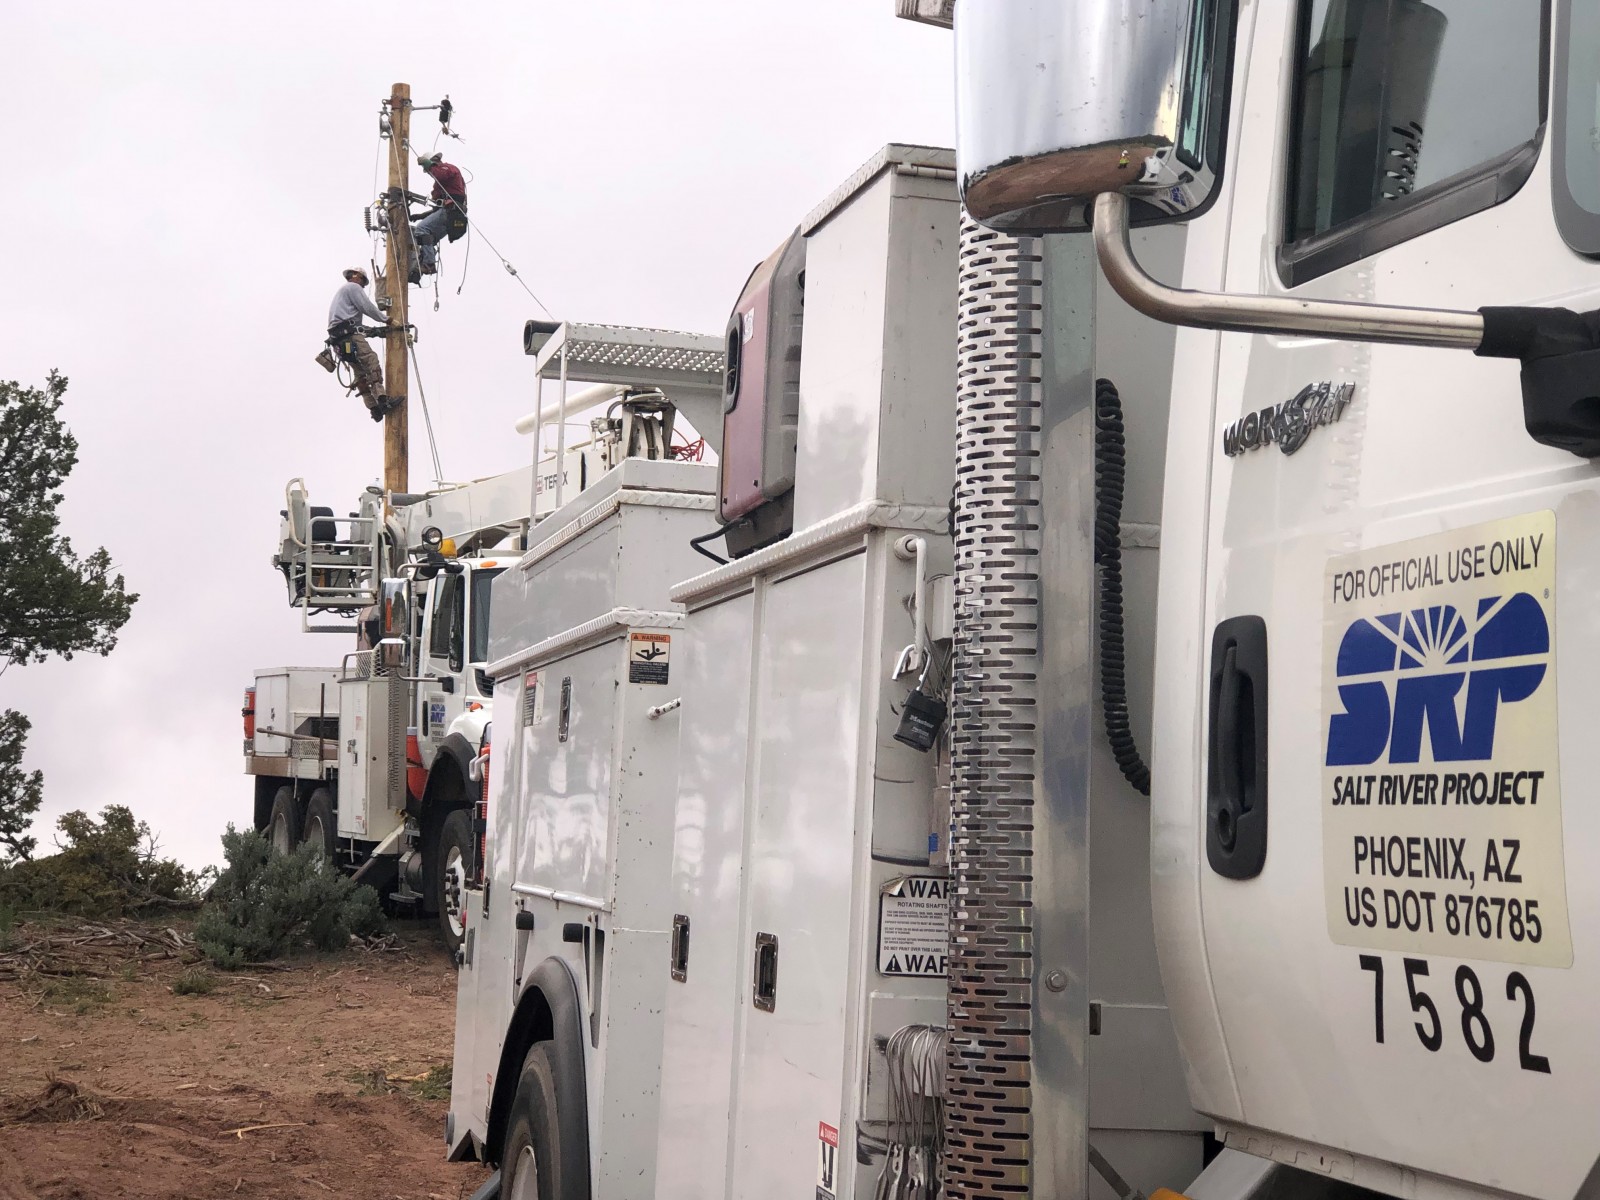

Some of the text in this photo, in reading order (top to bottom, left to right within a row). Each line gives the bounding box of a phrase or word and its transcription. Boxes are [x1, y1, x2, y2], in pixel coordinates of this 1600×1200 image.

[544, 471, 568, 490] TERX
[1333, 533, 1544, 603] FOR OFFICIAL USE ONLY
[1326, 592, 1550, 766] SRP
[1332, 771, 1545, 806] SALT RIVER PROJECT
[1354, 835, 1522, 890] PHOENIX, AZ
[897, 901, 925, 909] ROTATING
[1344, 886, 1543, 943] US DOT 876785
[1359, 954, 1552, 1075] 7582
